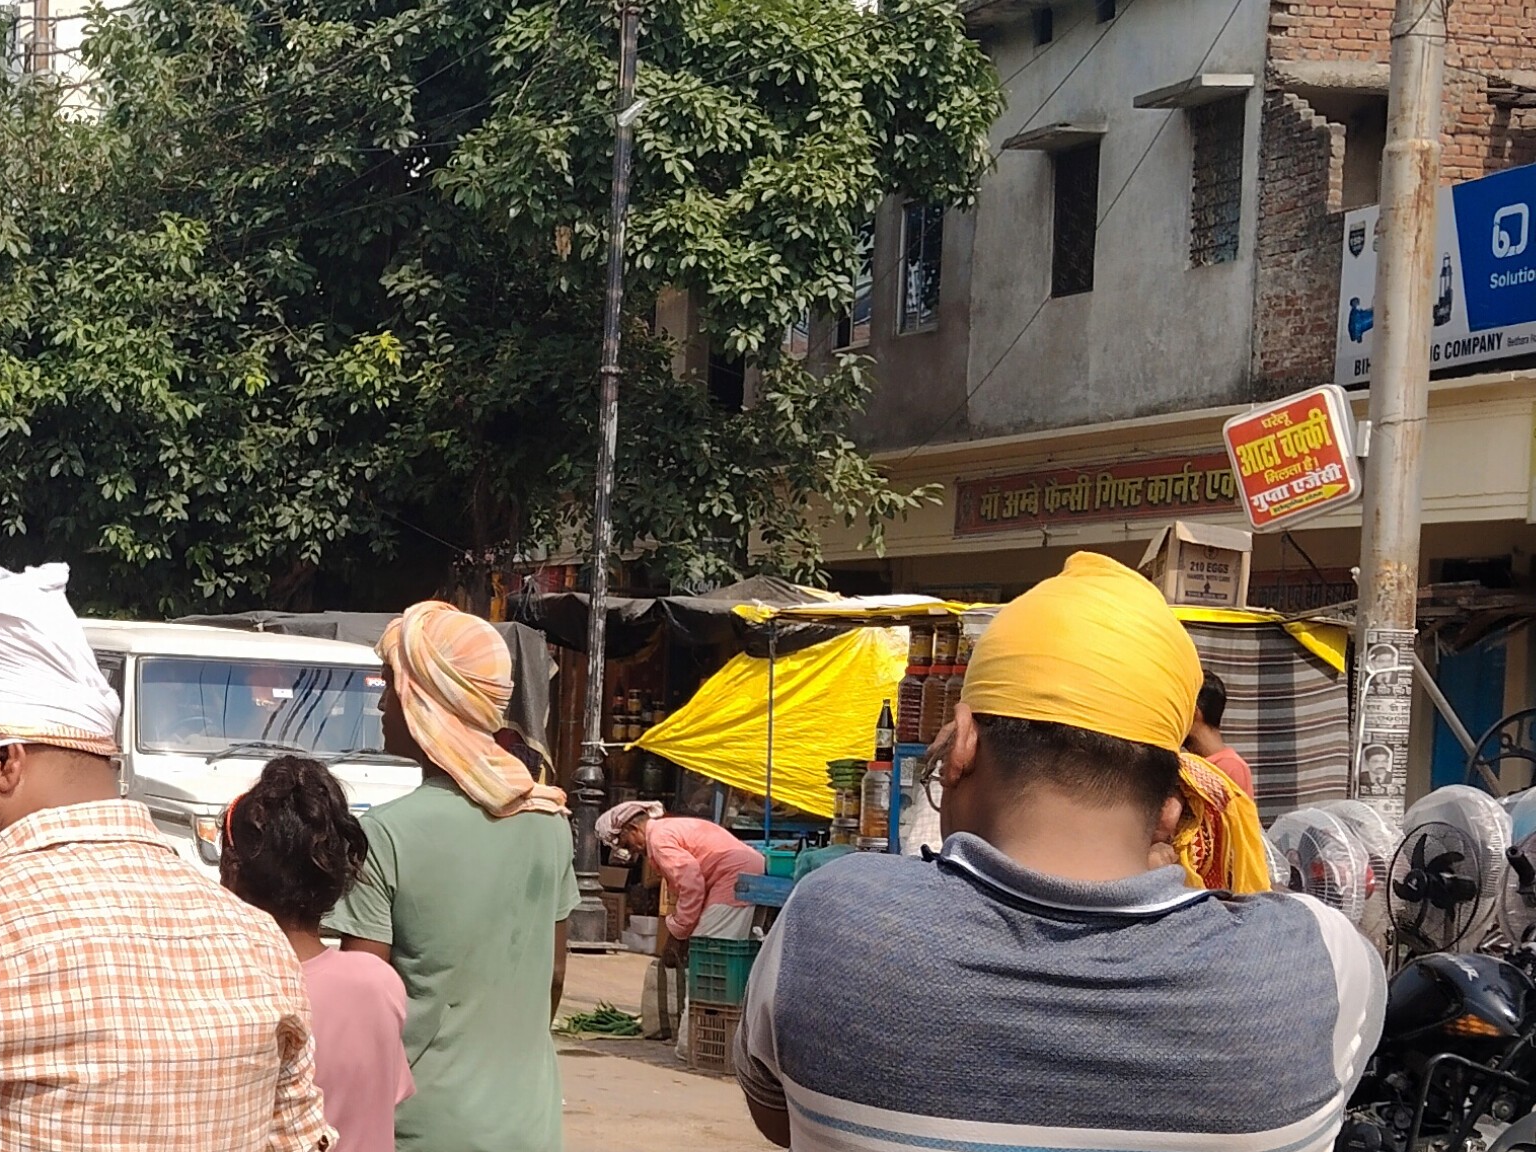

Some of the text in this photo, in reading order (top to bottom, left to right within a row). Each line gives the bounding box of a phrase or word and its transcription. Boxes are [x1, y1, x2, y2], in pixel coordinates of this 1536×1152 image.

[1489, 265, 1536, 289] Solutio
[1444, 332, 1503, 360] COMPANY
[1236, 408, 1333, 477] आटा चक्की
[1265, 464, 1302, 485] मिलता
[1095, 472, 1145, 510] गिफ्ट
[1206, 562, 1229, 574] EGGS
